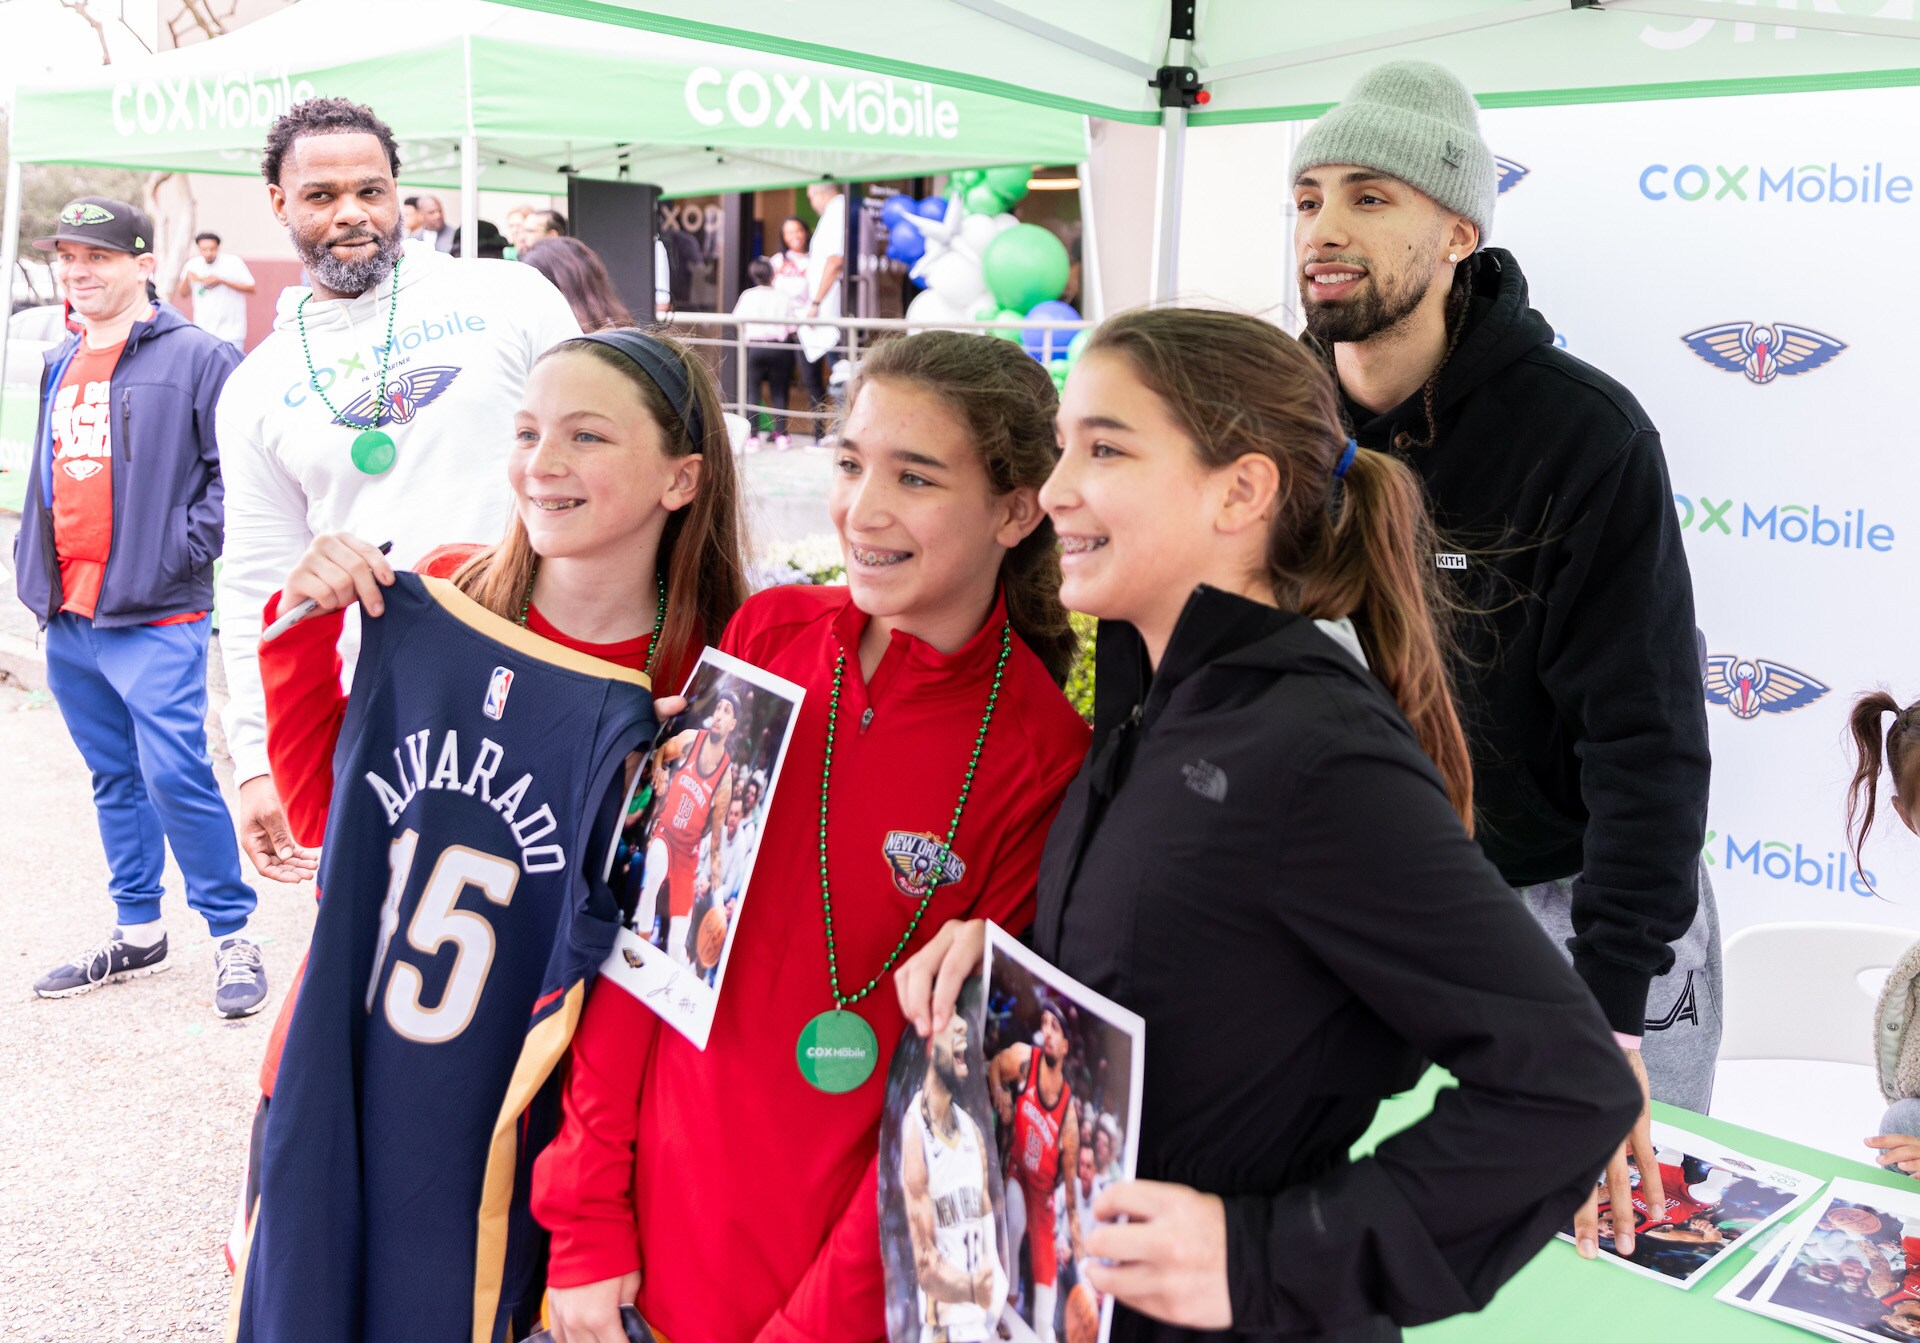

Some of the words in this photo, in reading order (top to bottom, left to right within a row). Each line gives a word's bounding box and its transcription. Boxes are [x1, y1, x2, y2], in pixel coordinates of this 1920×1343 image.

[112, 78, 194, 136] COX
[684, 66, 813, 129] COX
[1639, 164, 1749, 201] COX
[284, 351, 366, 408] COX
[1437, 555, 1464, 566] KITH
[364, 728, 567, 874] ALVARADO
[885, 832, 917, 853] NEW
[365, 828, 521, 1044] 15
[806, 1047, 832, 1059] COX
